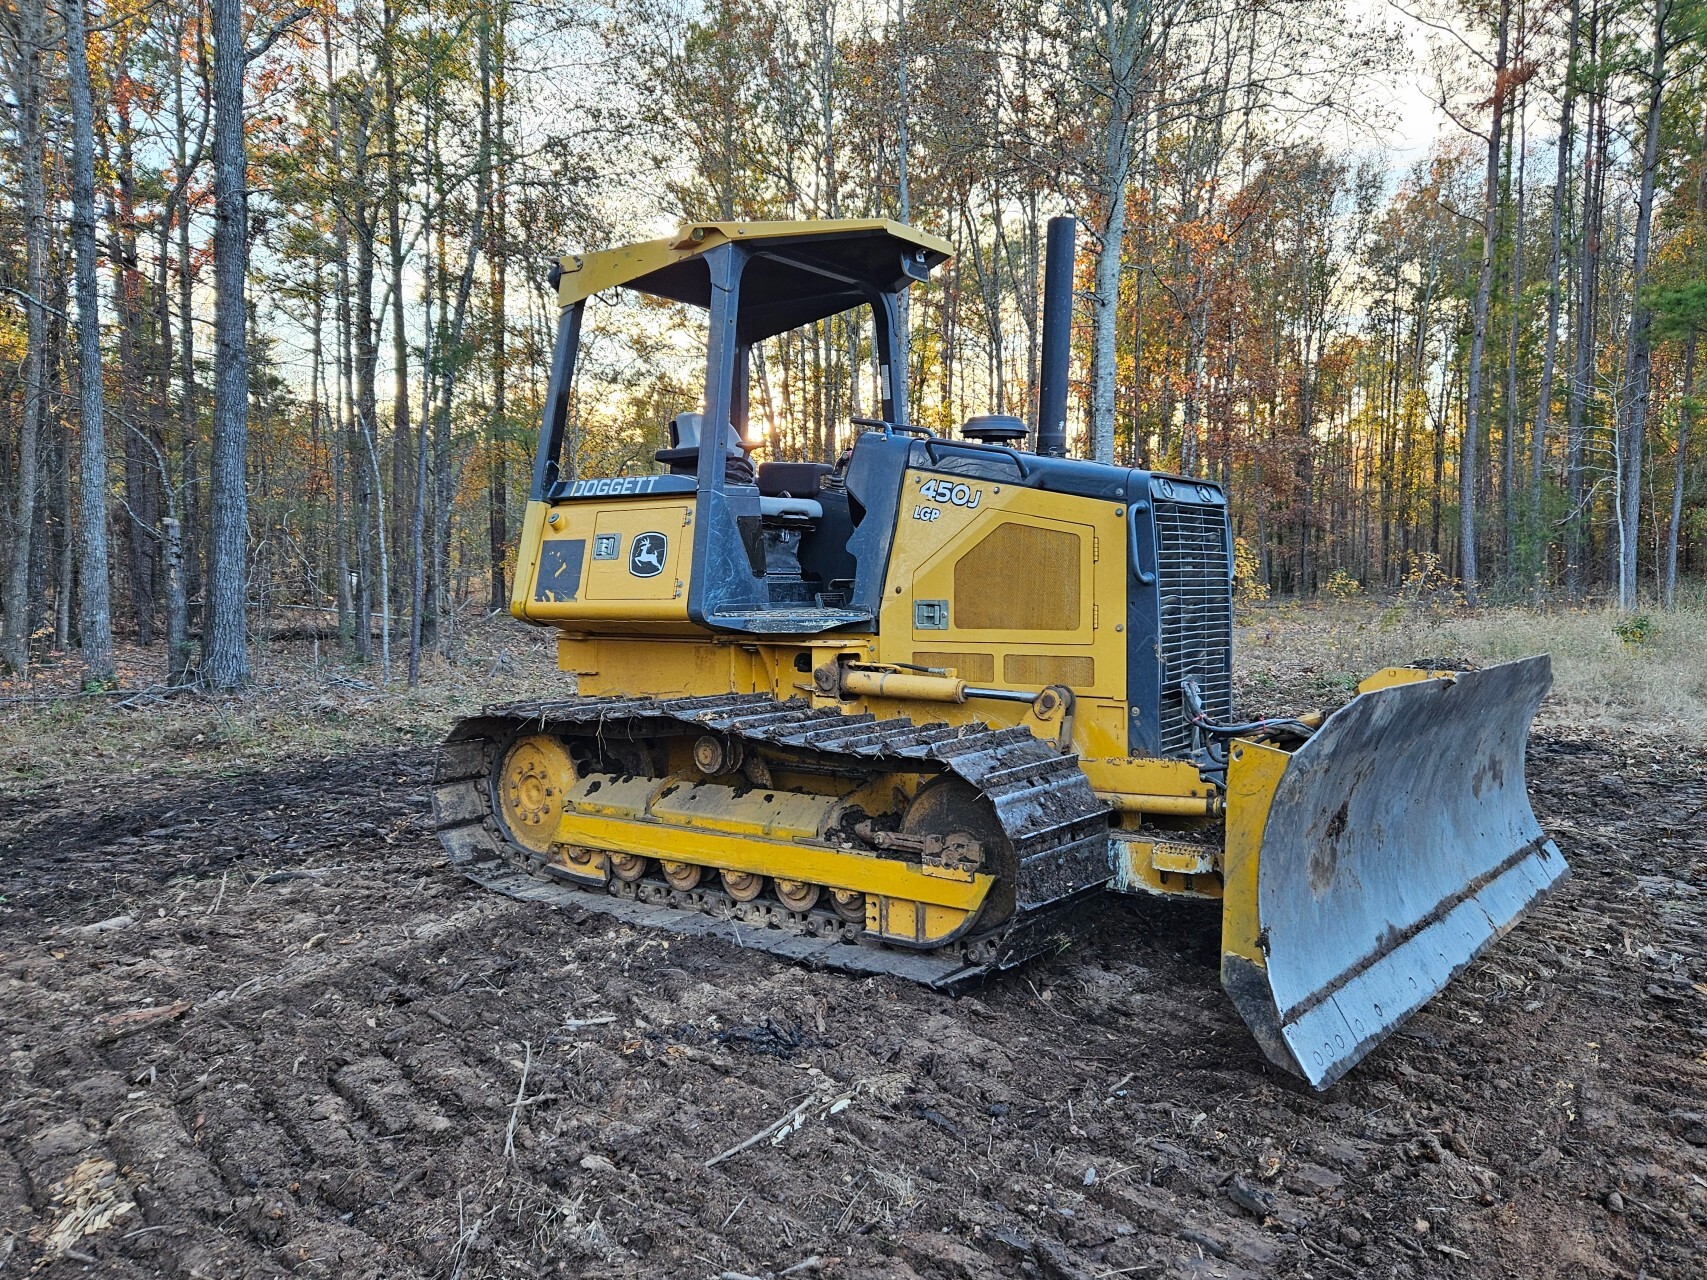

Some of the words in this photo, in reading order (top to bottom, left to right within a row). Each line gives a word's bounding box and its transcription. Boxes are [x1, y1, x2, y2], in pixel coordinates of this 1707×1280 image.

[570, 476, 660, 497] DOGGETT
[919, 478, 982, 508] 450J
[913, 505, 941, 522] LGP
